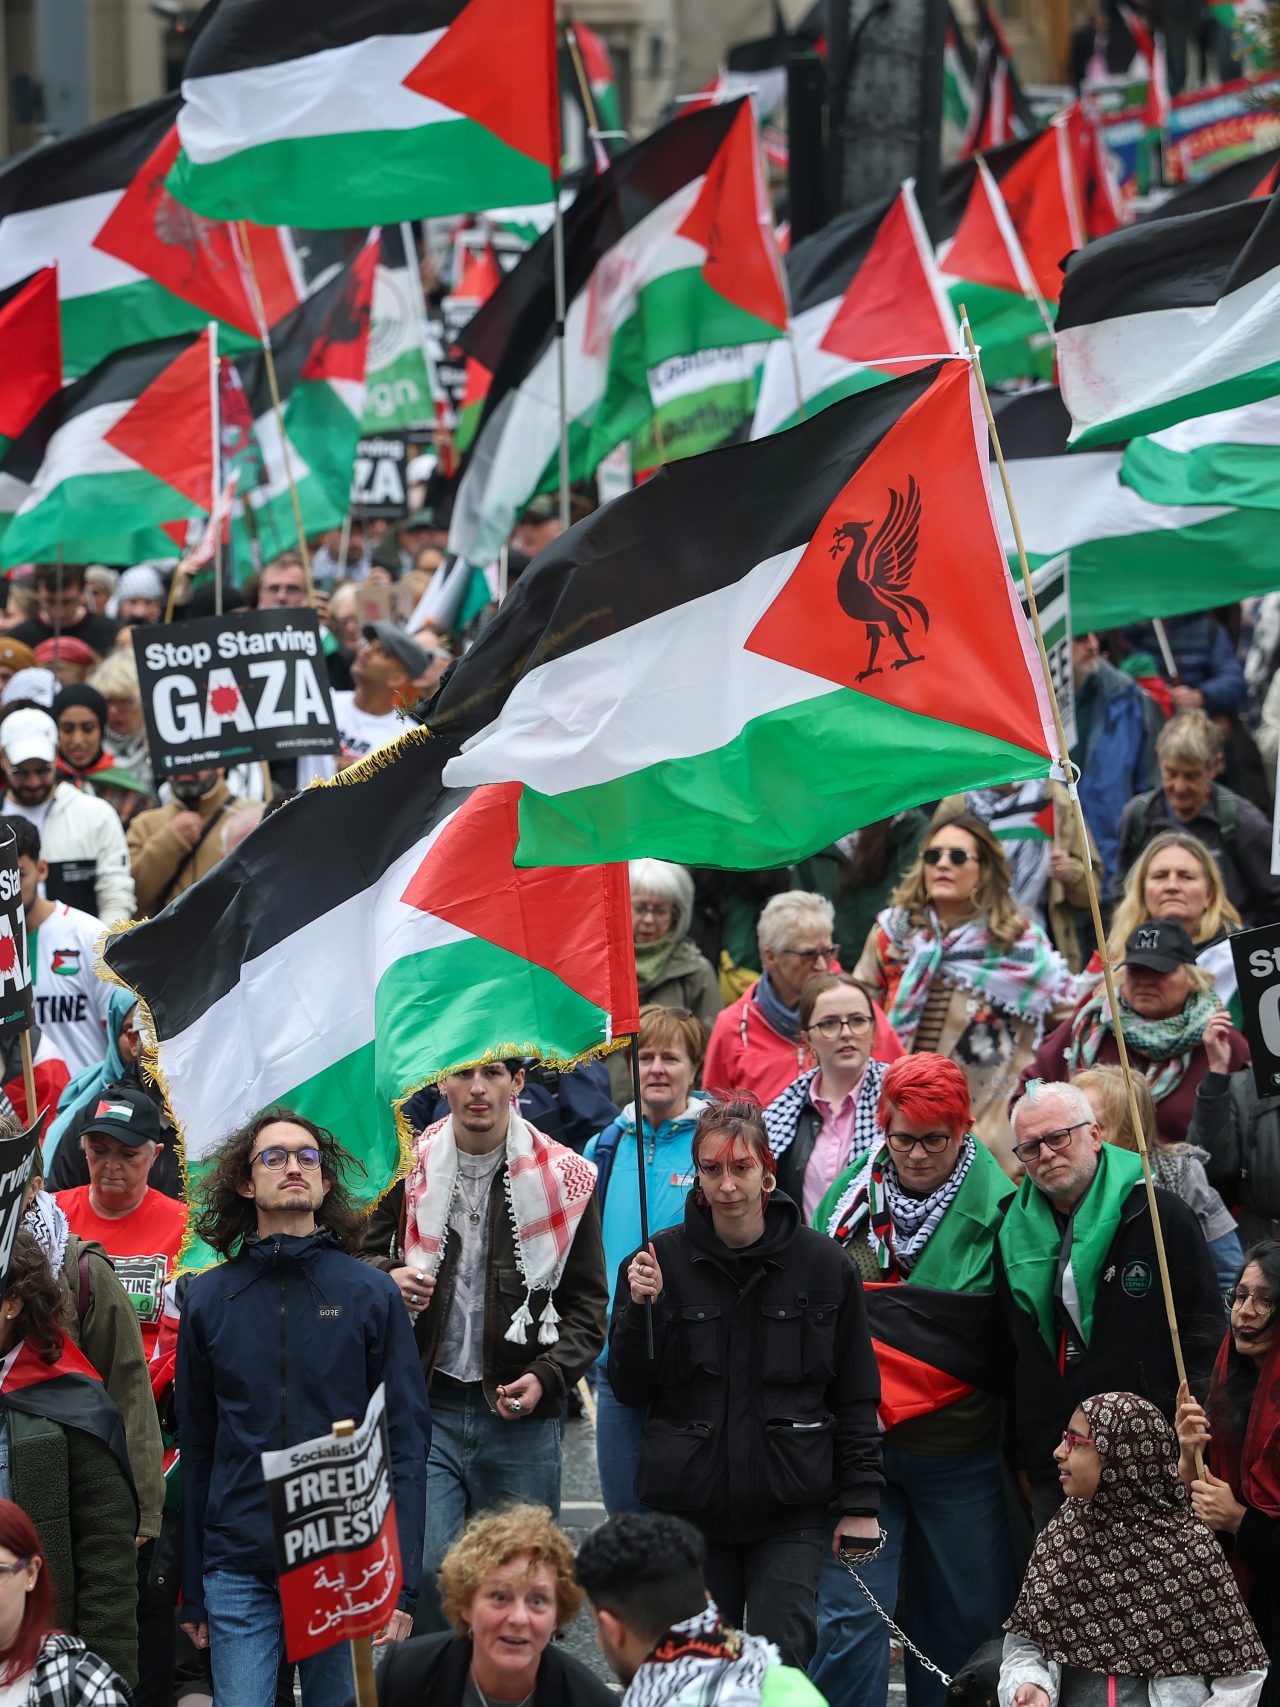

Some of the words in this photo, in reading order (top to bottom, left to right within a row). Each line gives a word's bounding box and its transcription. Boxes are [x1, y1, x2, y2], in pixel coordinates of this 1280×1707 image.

[145, 641, 212, 671] Stop
[216, 625, 318, 660] Starving
[152, 658, 331, 745] GAZA
[1135, 929, 1160, 950] M
[36, 994, 88, 1023] TINE
[319, 1309, 340, 1317] GORE
[290, 1441, 356, 1468] Socialist
[344, 1496, 367, 1515] for
